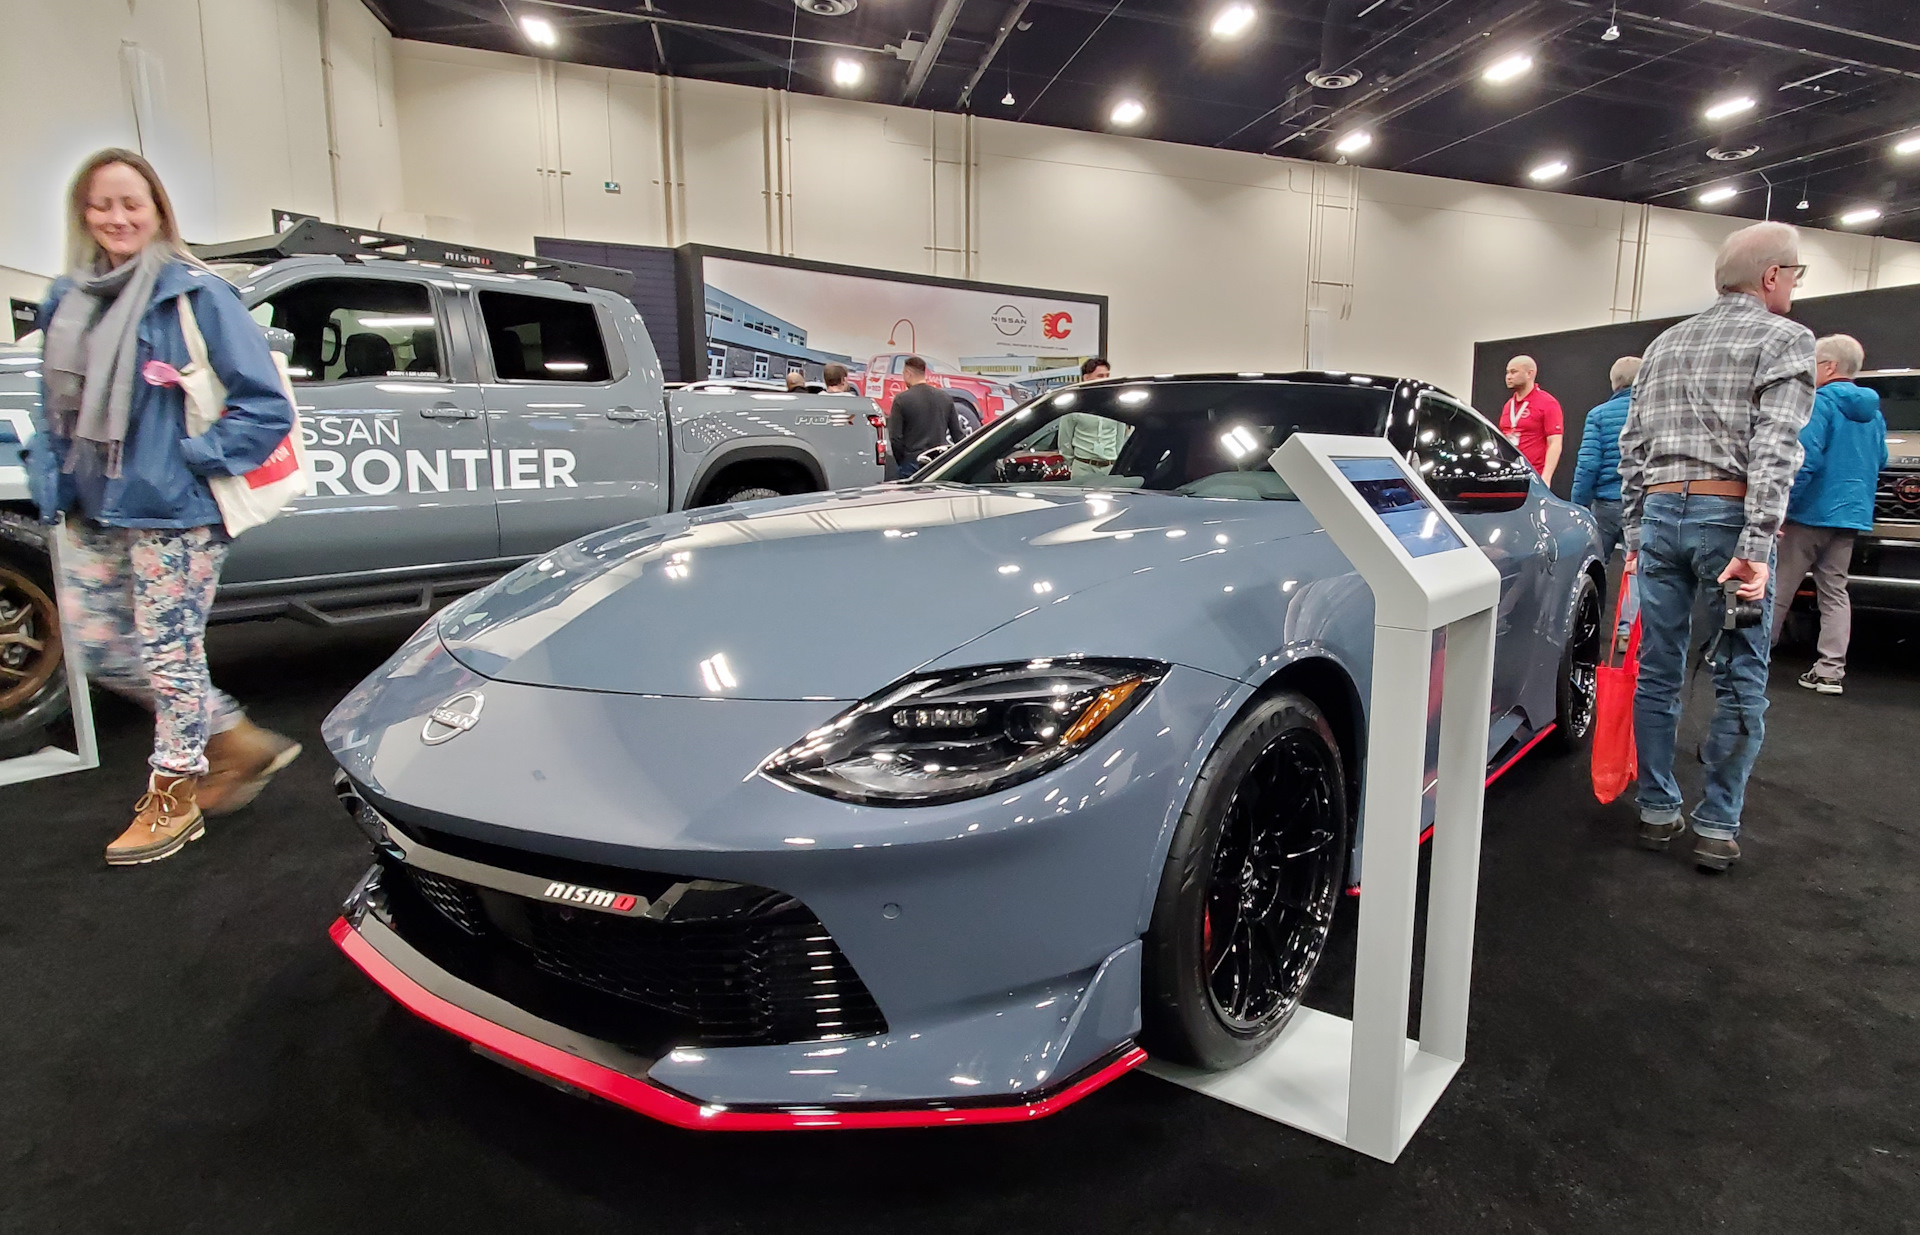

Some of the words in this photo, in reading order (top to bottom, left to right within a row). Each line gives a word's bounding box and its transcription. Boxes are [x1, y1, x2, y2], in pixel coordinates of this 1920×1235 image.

[445, 251, 490, 265] nismo
[991, 316, 1027, 325] NISSAN
[1043, 311, 1073, 339] C
[300, 417, 401, 446] SSAN
[304, 448, 579, 497] RONTIER
[544, 882, 638, 912] nismo
